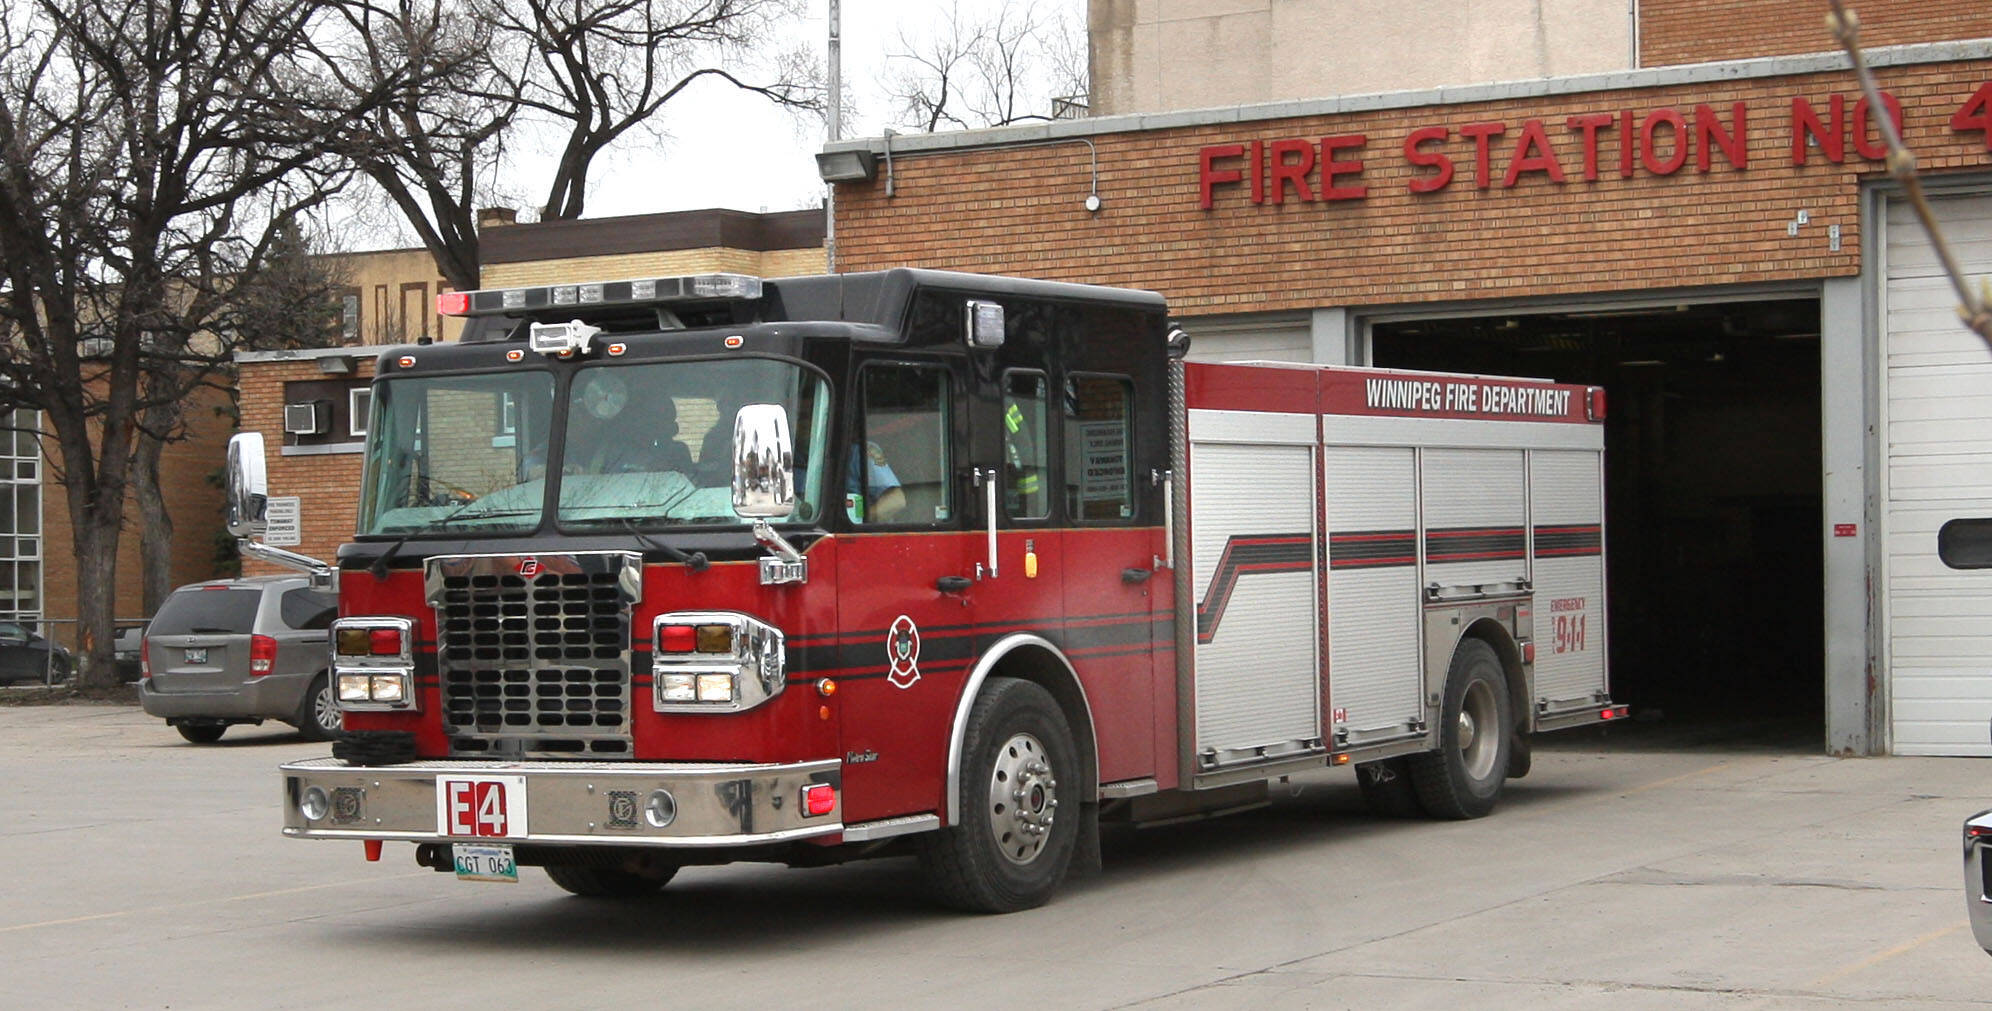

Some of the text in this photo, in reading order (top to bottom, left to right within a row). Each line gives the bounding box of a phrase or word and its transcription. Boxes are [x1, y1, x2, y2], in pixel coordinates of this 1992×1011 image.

[1200, 80, 1992, 210] FIRE STATION NO 4
[1366, 378, 1571, 416] WINNIPEG FIRE DEPARTMENT
[450, 782, 505, 835] E4
[456, 855, 513, 874] CGT 063
